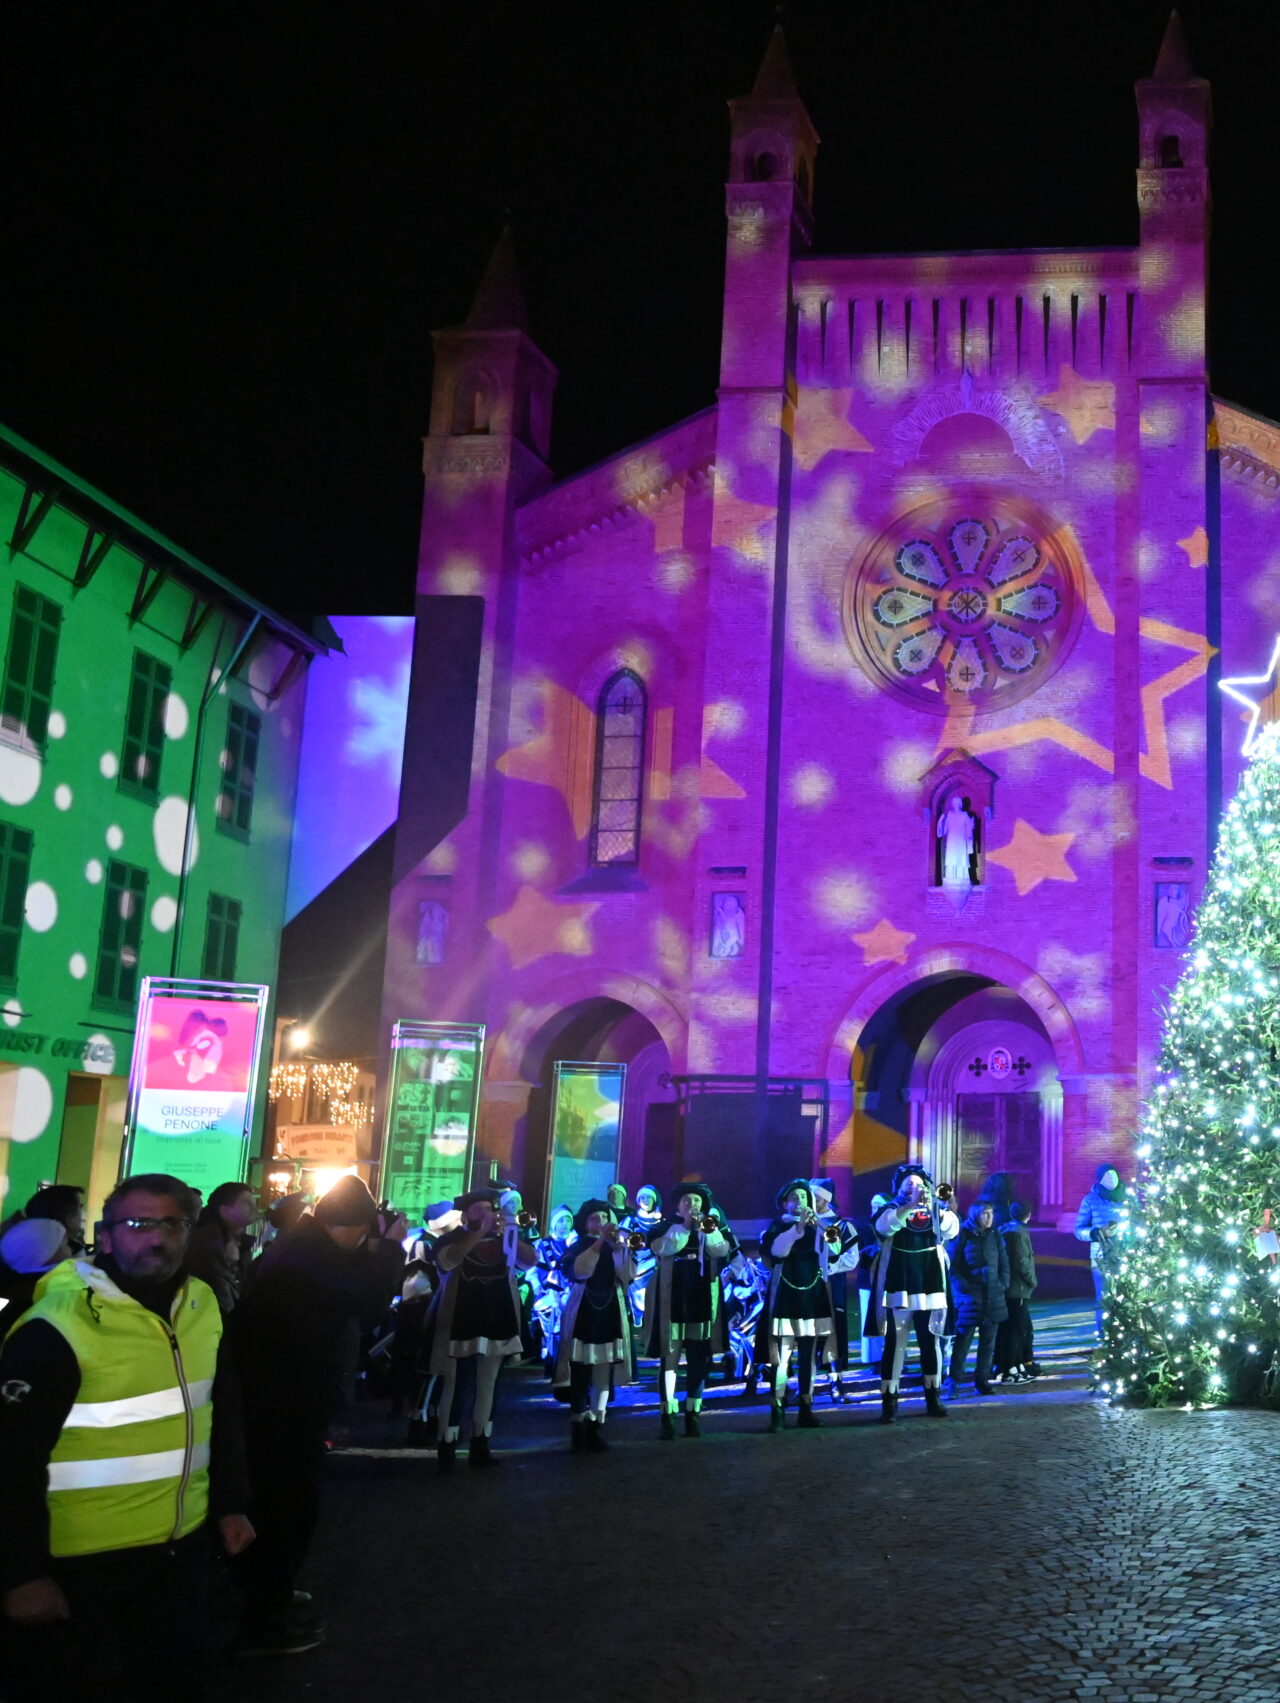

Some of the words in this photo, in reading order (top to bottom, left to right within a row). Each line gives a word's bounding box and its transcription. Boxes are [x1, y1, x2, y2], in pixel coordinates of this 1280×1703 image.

[51, 1037, 114, 1064] OFFICE
[161, 1105, 224, 1118] GIUSEPPE
[164, 1118, 218, 1131] PENONE
